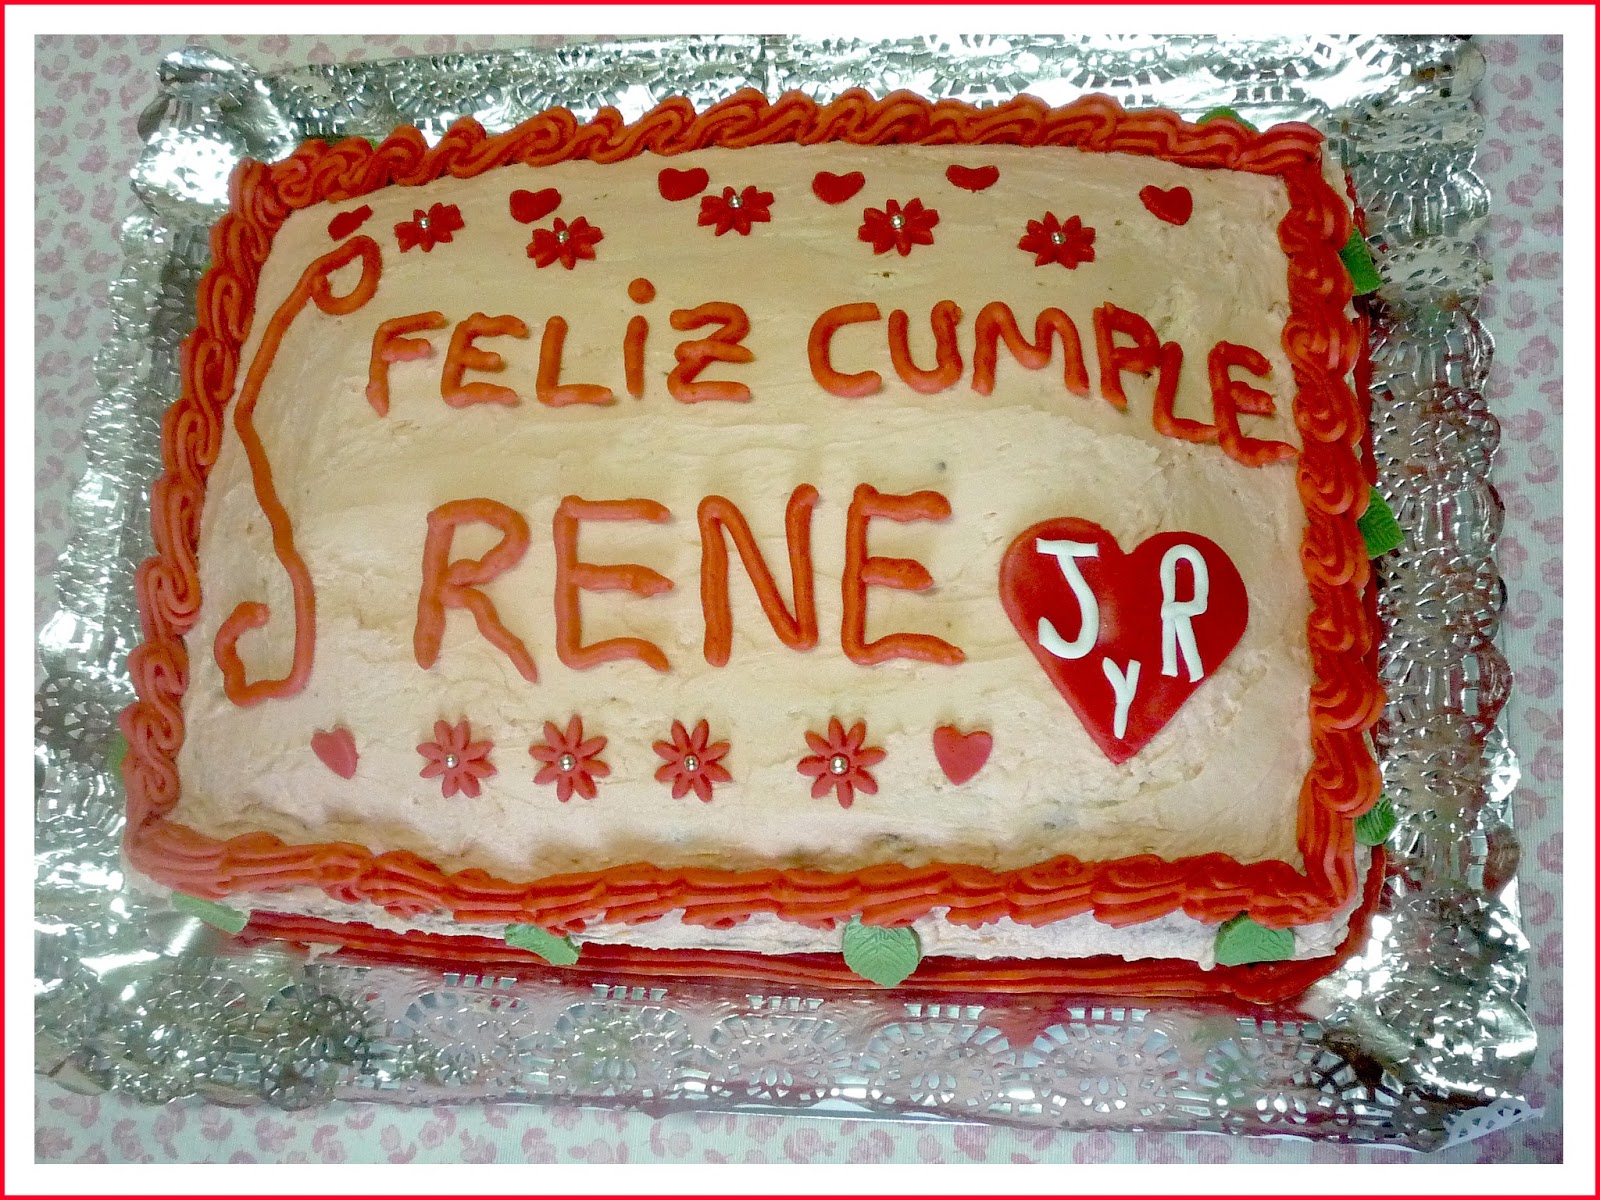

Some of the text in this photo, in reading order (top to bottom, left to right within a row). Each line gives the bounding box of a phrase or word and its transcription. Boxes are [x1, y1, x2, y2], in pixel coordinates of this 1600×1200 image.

[807, 299, 1298, 467] CUMPLE
[413, 483, 967, 684] RENE
[1036, 538, 1100, 660] J
[1159, 543, 1210, 683] R
